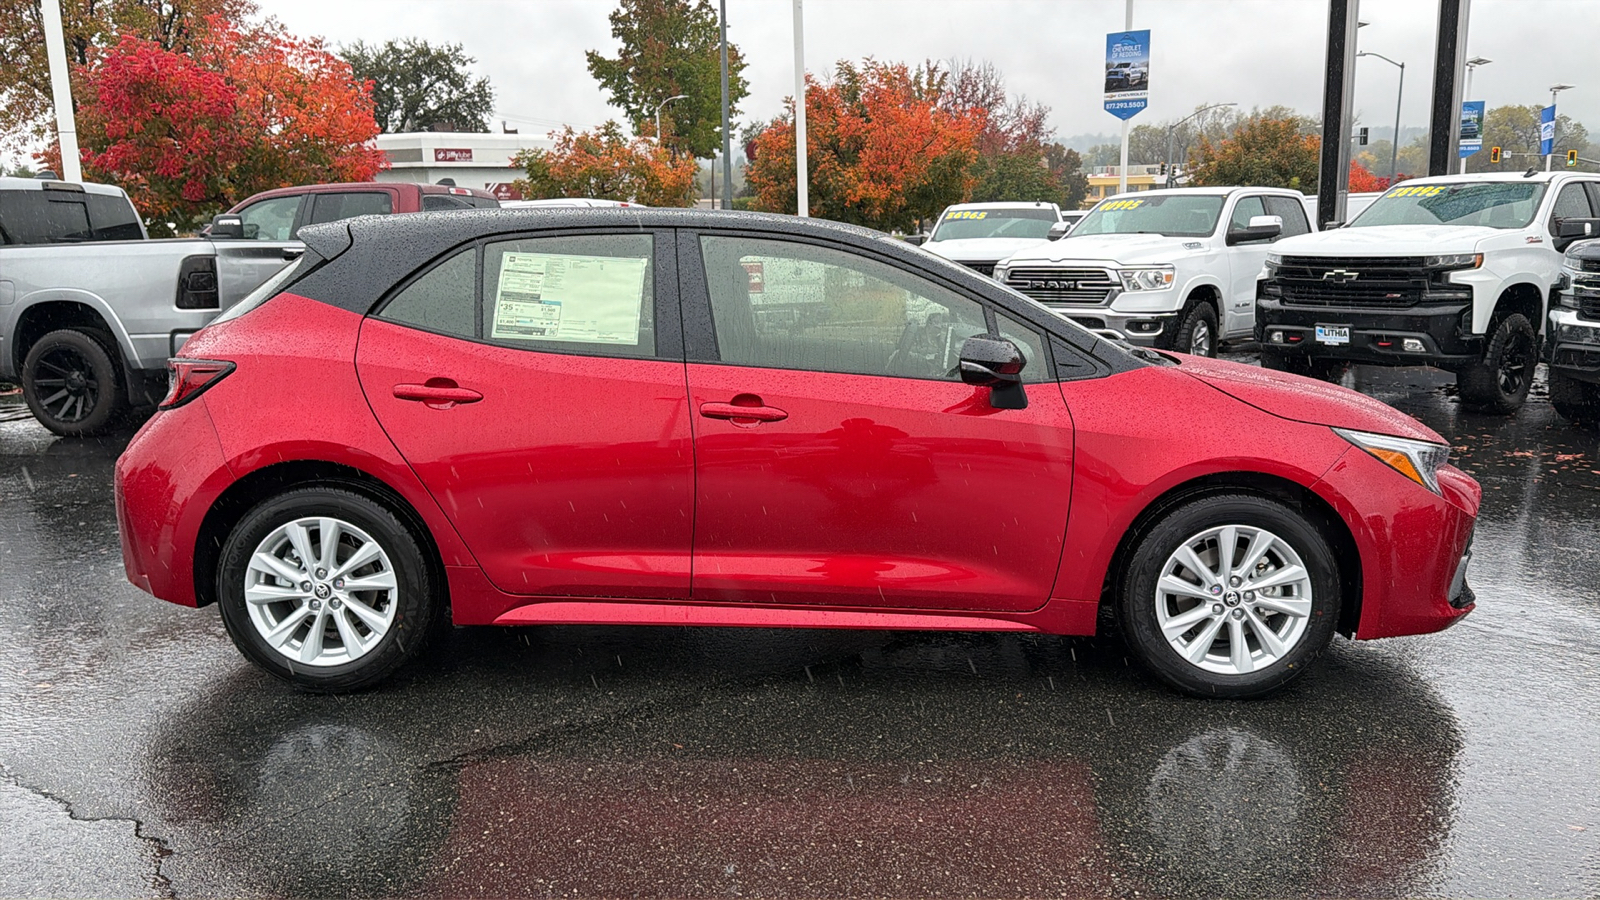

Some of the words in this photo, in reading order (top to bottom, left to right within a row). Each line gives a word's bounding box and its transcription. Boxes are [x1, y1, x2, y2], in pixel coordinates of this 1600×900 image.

[1112, 45, 1141, 53] CHEVROLET
[503, 303, 514, 311] 35
[1324, 328, 1348, 337] LITHIA
